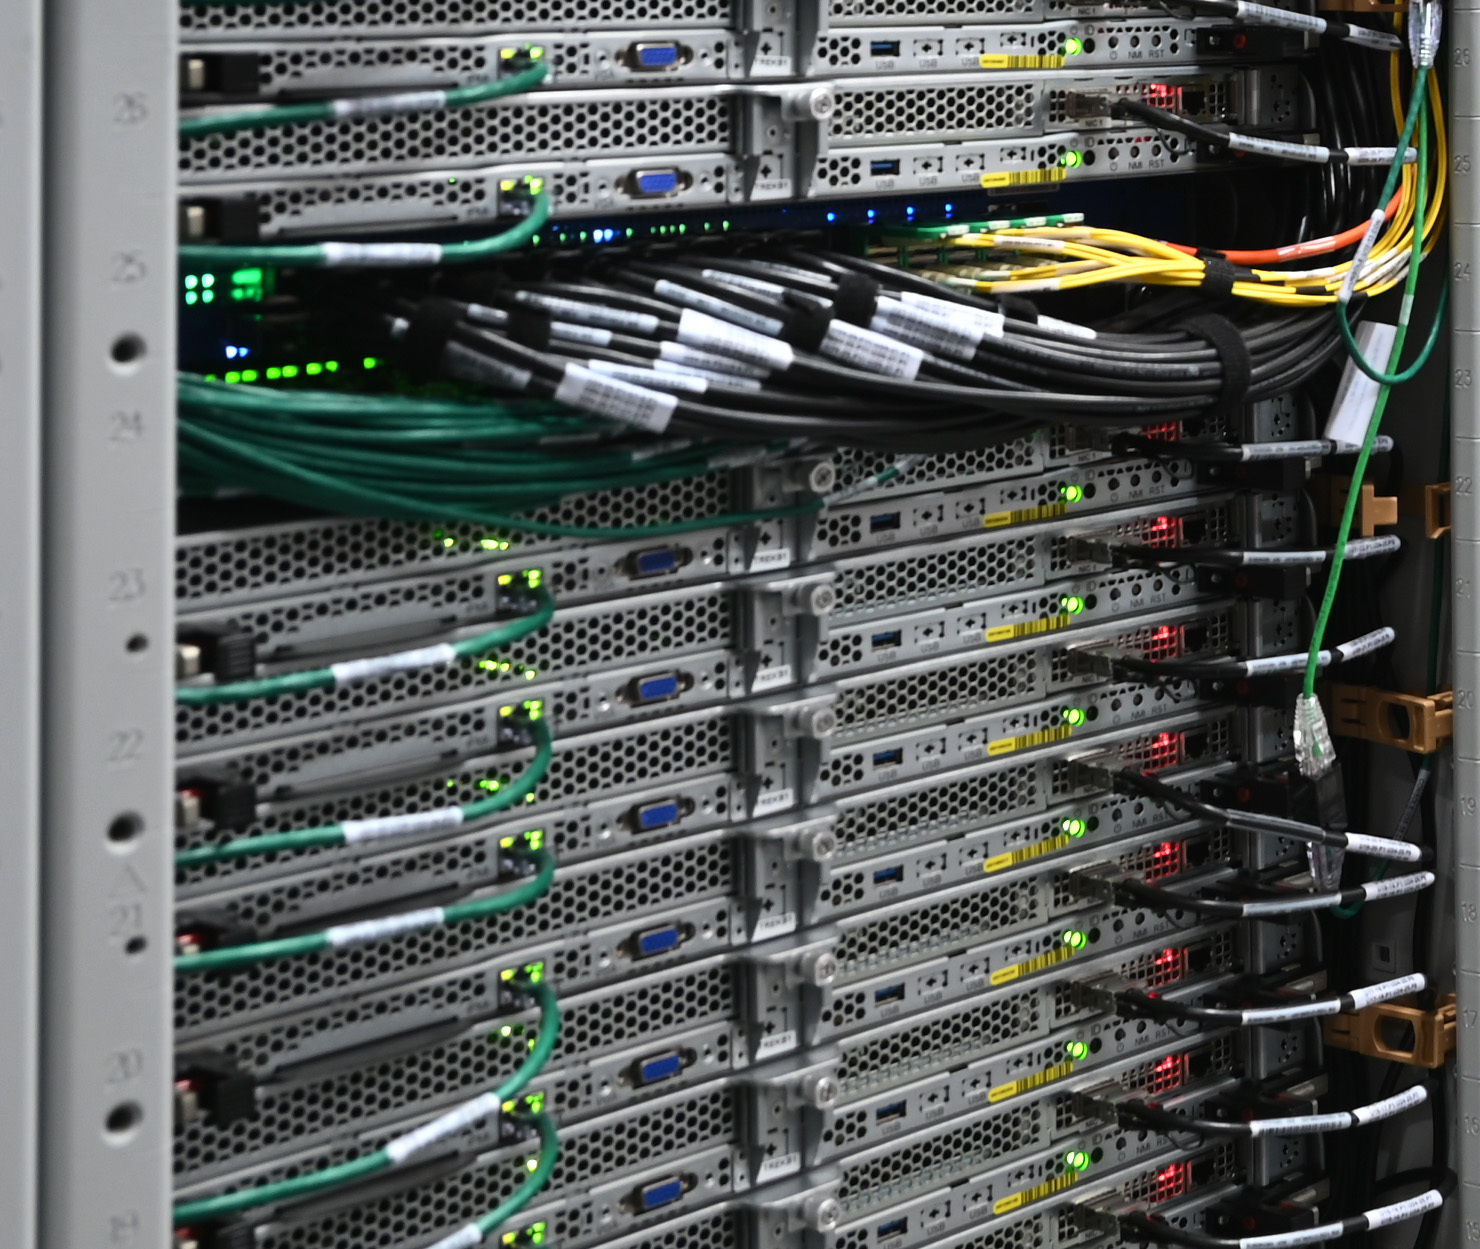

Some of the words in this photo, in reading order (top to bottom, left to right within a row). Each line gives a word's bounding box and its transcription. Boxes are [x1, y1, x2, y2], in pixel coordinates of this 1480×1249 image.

[1454, 154, 1472, 174] 25
[1454, 262, 1471, 282] 24
[1455, 368, 1472, 389] 23
[1455, 476, 1472, 495] 22
[1458, 689, 1475, 710] 20
[1461, 796, 1476, 816] 19
[1462, 902, 1477, 923] 18
[1463, 1009, 1478, 1028] 17
[1464, 1113, 1480, 1136] 16
[1465, 1221, 1480, 1242] 15
